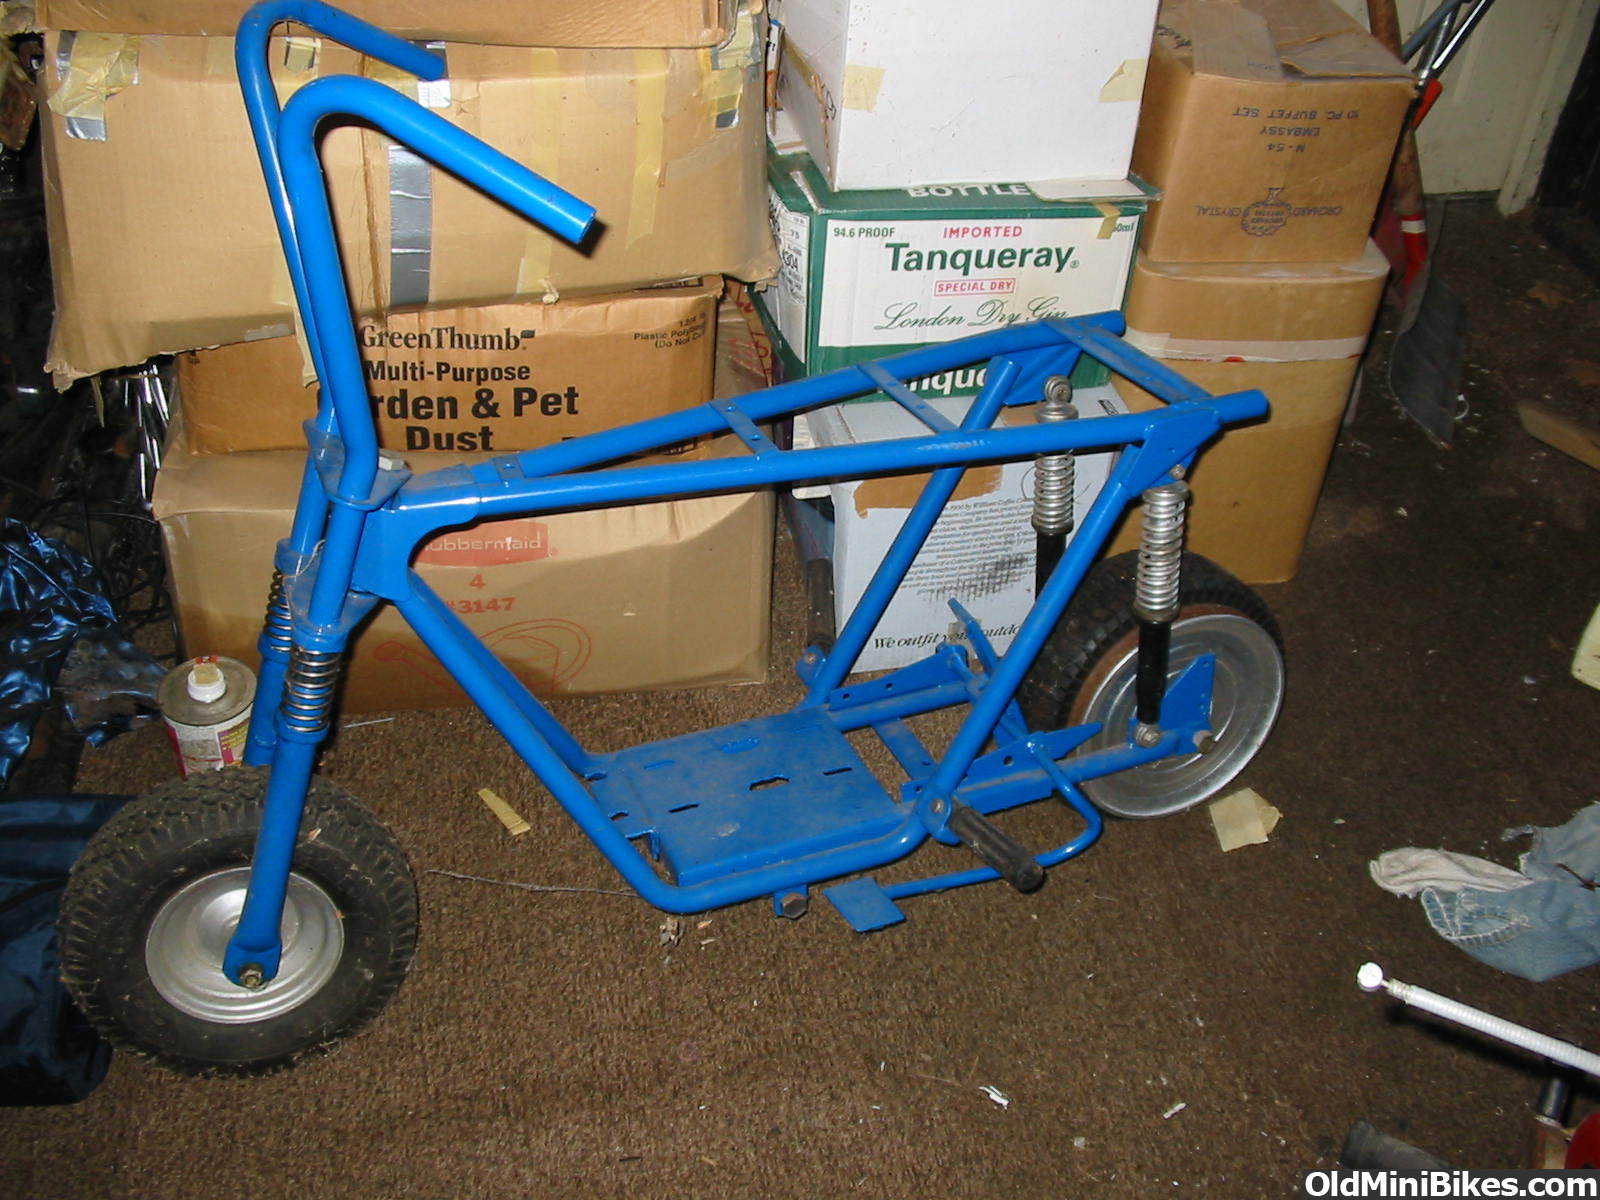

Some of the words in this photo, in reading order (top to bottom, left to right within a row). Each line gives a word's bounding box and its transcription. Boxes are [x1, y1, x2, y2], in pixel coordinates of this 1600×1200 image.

[1232, 106, 1260, 118] SET
[1267, 109, 1318, 120] BUFFET
[1260, 126, 1320, 137] EMBASSY
[907, 183, 1031, 198] BOTTLE
[1196, 205, 1242, 217] CRYSTAL
[833, 227, 855, 238] 94.6
[858, 227, 896, 238] PROOF
[943, 225, 1022, 239] IMPORTED
[885, 242, 1075, 277] Tanqueray
[938, 281, 986, 293] SPECIAL
[990, 280, 1013, 291] DRY
[874, 302, 965, 330] London
[967, 299, 1021, 326] Dry
[1026, 296, 1068, 320] Gin
[360, 326, 521, 351] GreenThumb
[364, 361, 531, 385] Multi-Purpose
[471, 388, 500, 419] &
[513, 386, 579, 417] Pet
[406, 426, 493, 452] Dust
[469, 573, 486, 589] 4
[874, 637, 896, 649] We
[897, 632, 940, 648] outfit
[943, 631, 969, 642] you
